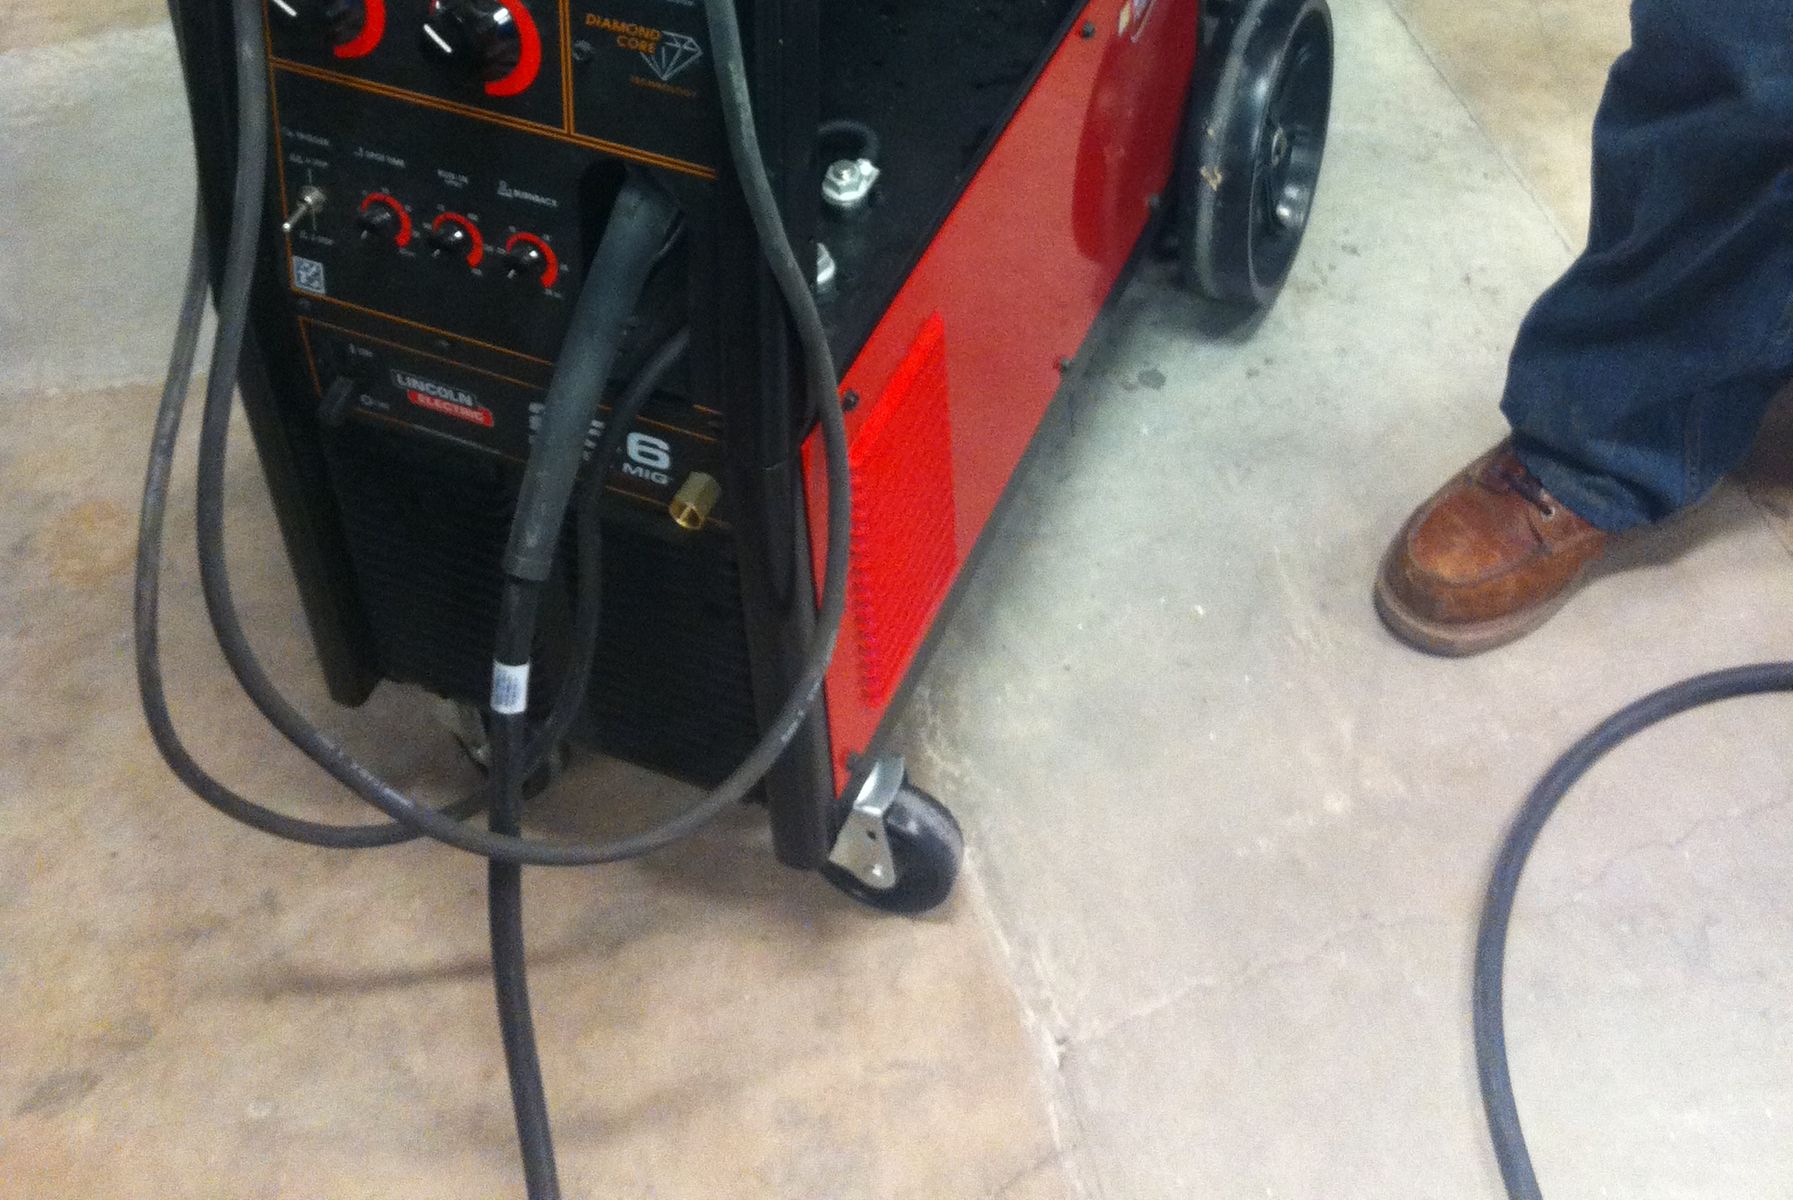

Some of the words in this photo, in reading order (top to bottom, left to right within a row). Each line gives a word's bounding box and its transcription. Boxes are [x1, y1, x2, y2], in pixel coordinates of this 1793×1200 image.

[585, 12, 662, 43] DIAMOND
[616, 34, 657, 55] CORE
[396, 373, 473, 406] LINCOLN
[622, 462, 670, 485] MIG
